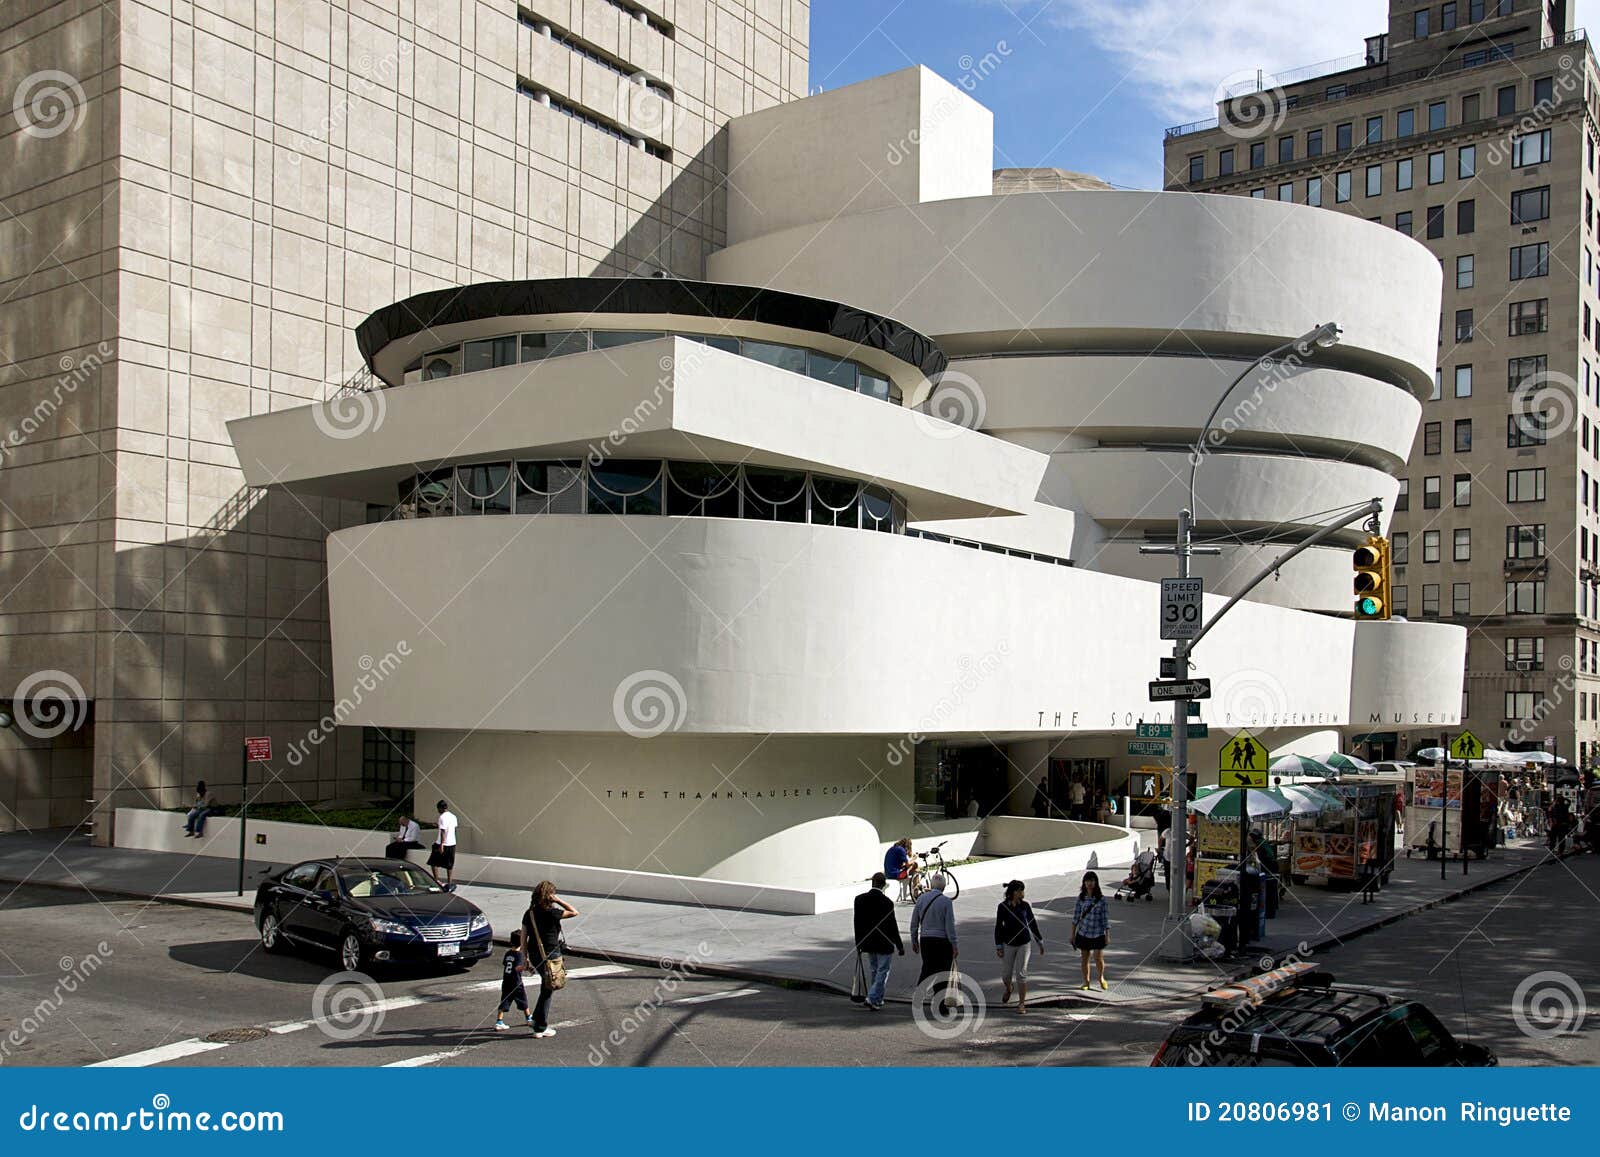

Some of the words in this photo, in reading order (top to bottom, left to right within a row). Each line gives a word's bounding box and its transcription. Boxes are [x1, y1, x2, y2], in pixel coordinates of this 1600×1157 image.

[1164, 583, 1200, 592] SPEED
[1167, 593, 1196, 602] LIMIT
[1165, 603, 1198, 623] 30
[1157, 687, 1174, 696] ONE
[1185, 684, 1202, 694] WAY
[1038, 711, 1078, 727] THE
[1252, 712, 1338, 725] GUGGENHEIM
[1369, 712, 1456, 723] MUSEUM
[1139, 725, 1145, 737] E
[1148, 725, 1160, 737] 89
[1128, 742, 1145, 751] FRED
[606, 790, 645, 799] THE
[663, 788, 812, 799] THANNHAUSER
[505, 961, 513, 974] 2
